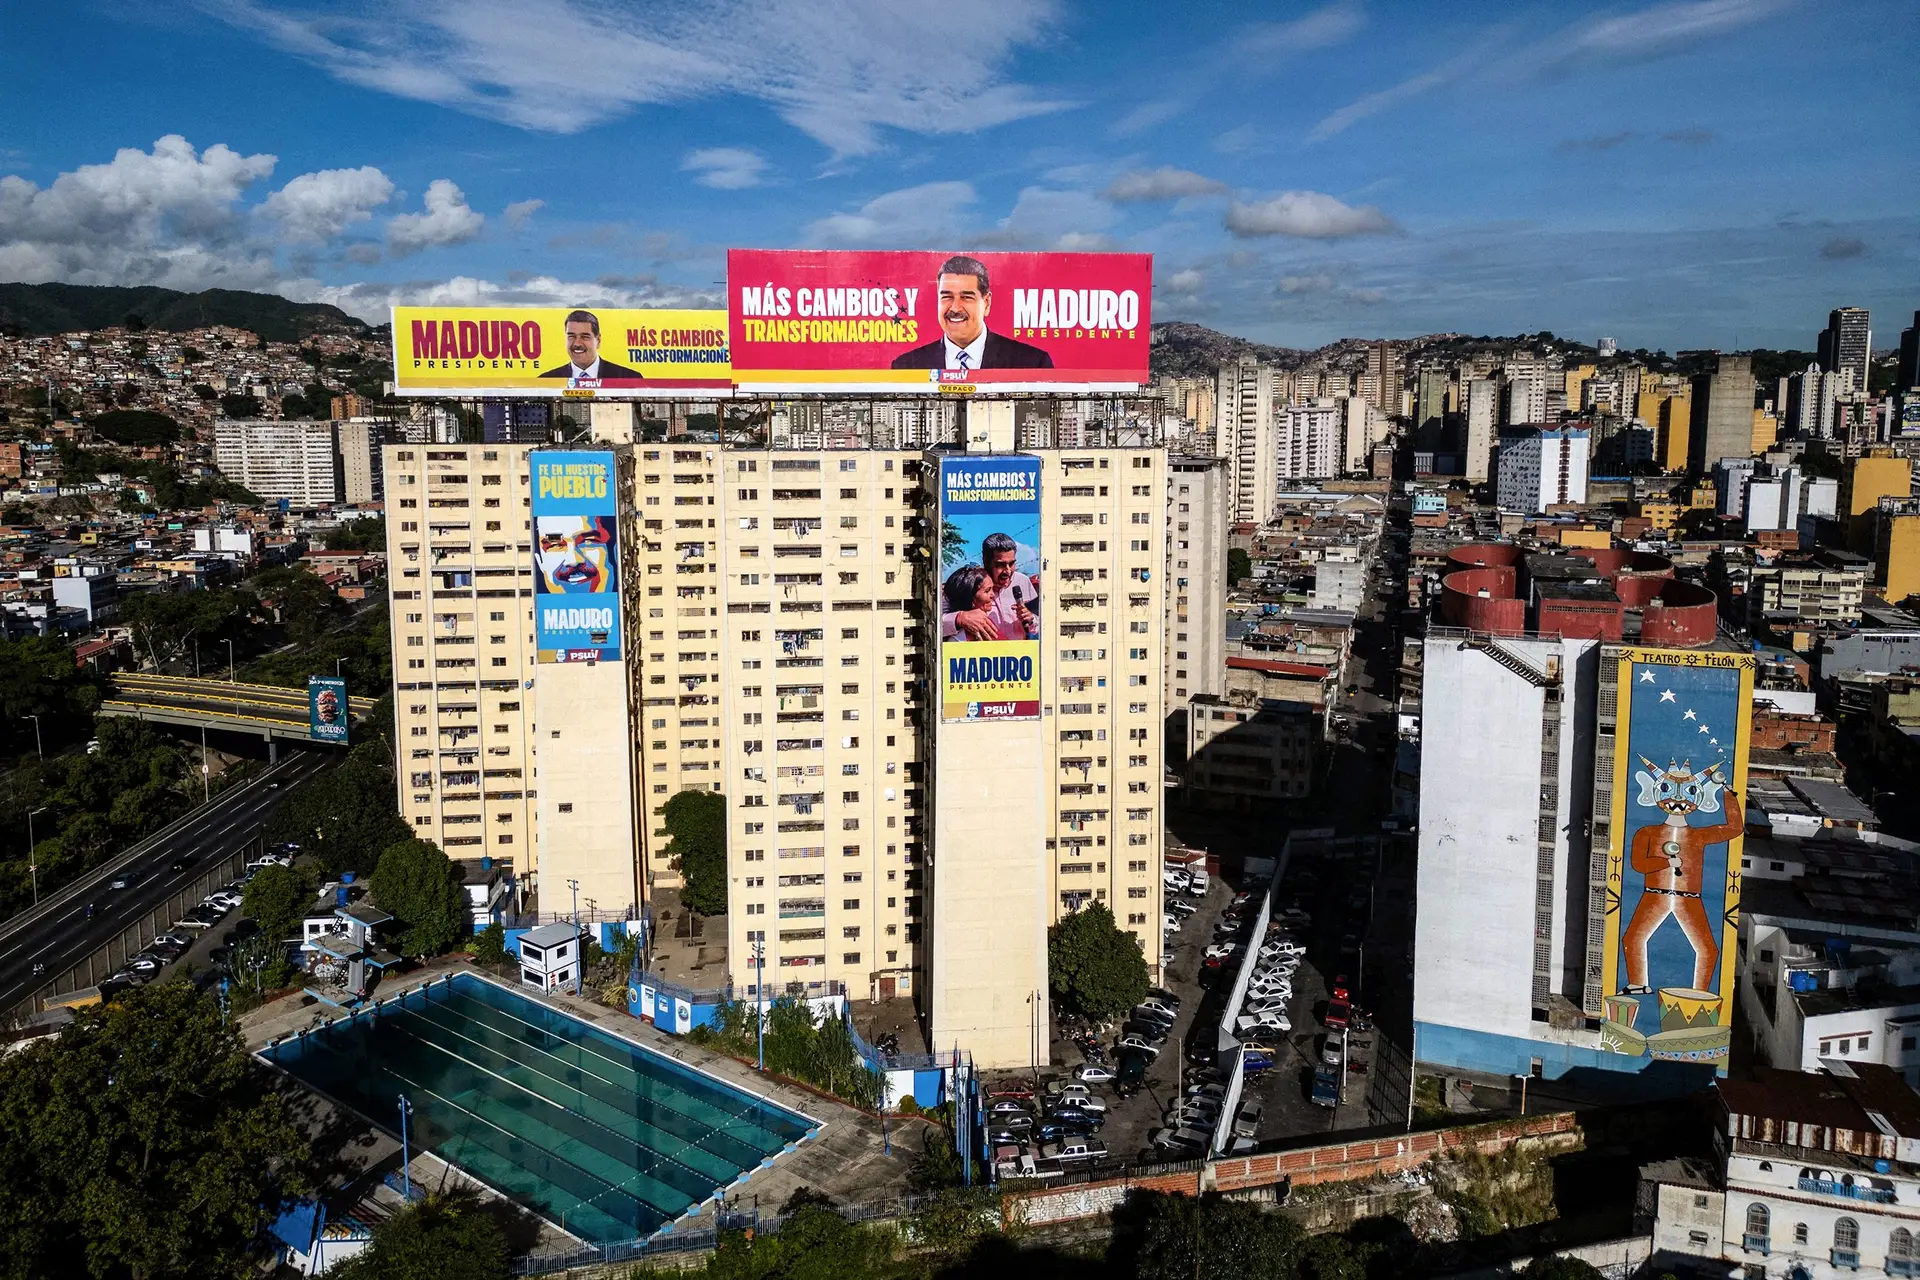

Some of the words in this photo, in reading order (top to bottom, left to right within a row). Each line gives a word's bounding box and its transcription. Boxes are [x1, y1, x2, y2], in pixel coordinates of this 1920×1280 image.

[742, 283, 790, 316] MÁS
[797, 288, 897, 317] CAMBIOS
[904, 288, 918, 316] Y
[1013, 289, 1139, 329] MADURO
[411, 319, 542, 360] MADURO
[627, 326, 657, 347] MÁS
[661, 329, 724, 347] CAMBIOS
[742, 319, 919, 343] TRANSFORMACIONES
[1014, 329, 1136, 339] PRESIDENTE
[414, 360, 540, 369] PRESIDENTE
[628, 349, 732, 363] TRANSFORMACIONE
[538, 464, 549, 475] FE
[551, 464, 563, 475] EN
[565, 464, 607, 475] NUESTRO
[947, 470, 972, 488] MÁS
[974, 472, 1026, 488] CAMBIOS
[1028, 472, 1036, 487] Y
[539, 475, 607, 499] PUEBLO
[947, 488, 1036, 502] TRANSFORMACIONES
[543, 607, 613, 630] MADURO
[1641, 653, 1681, 664] TEATRO
[949, 656, 1033, 683] MADURO
